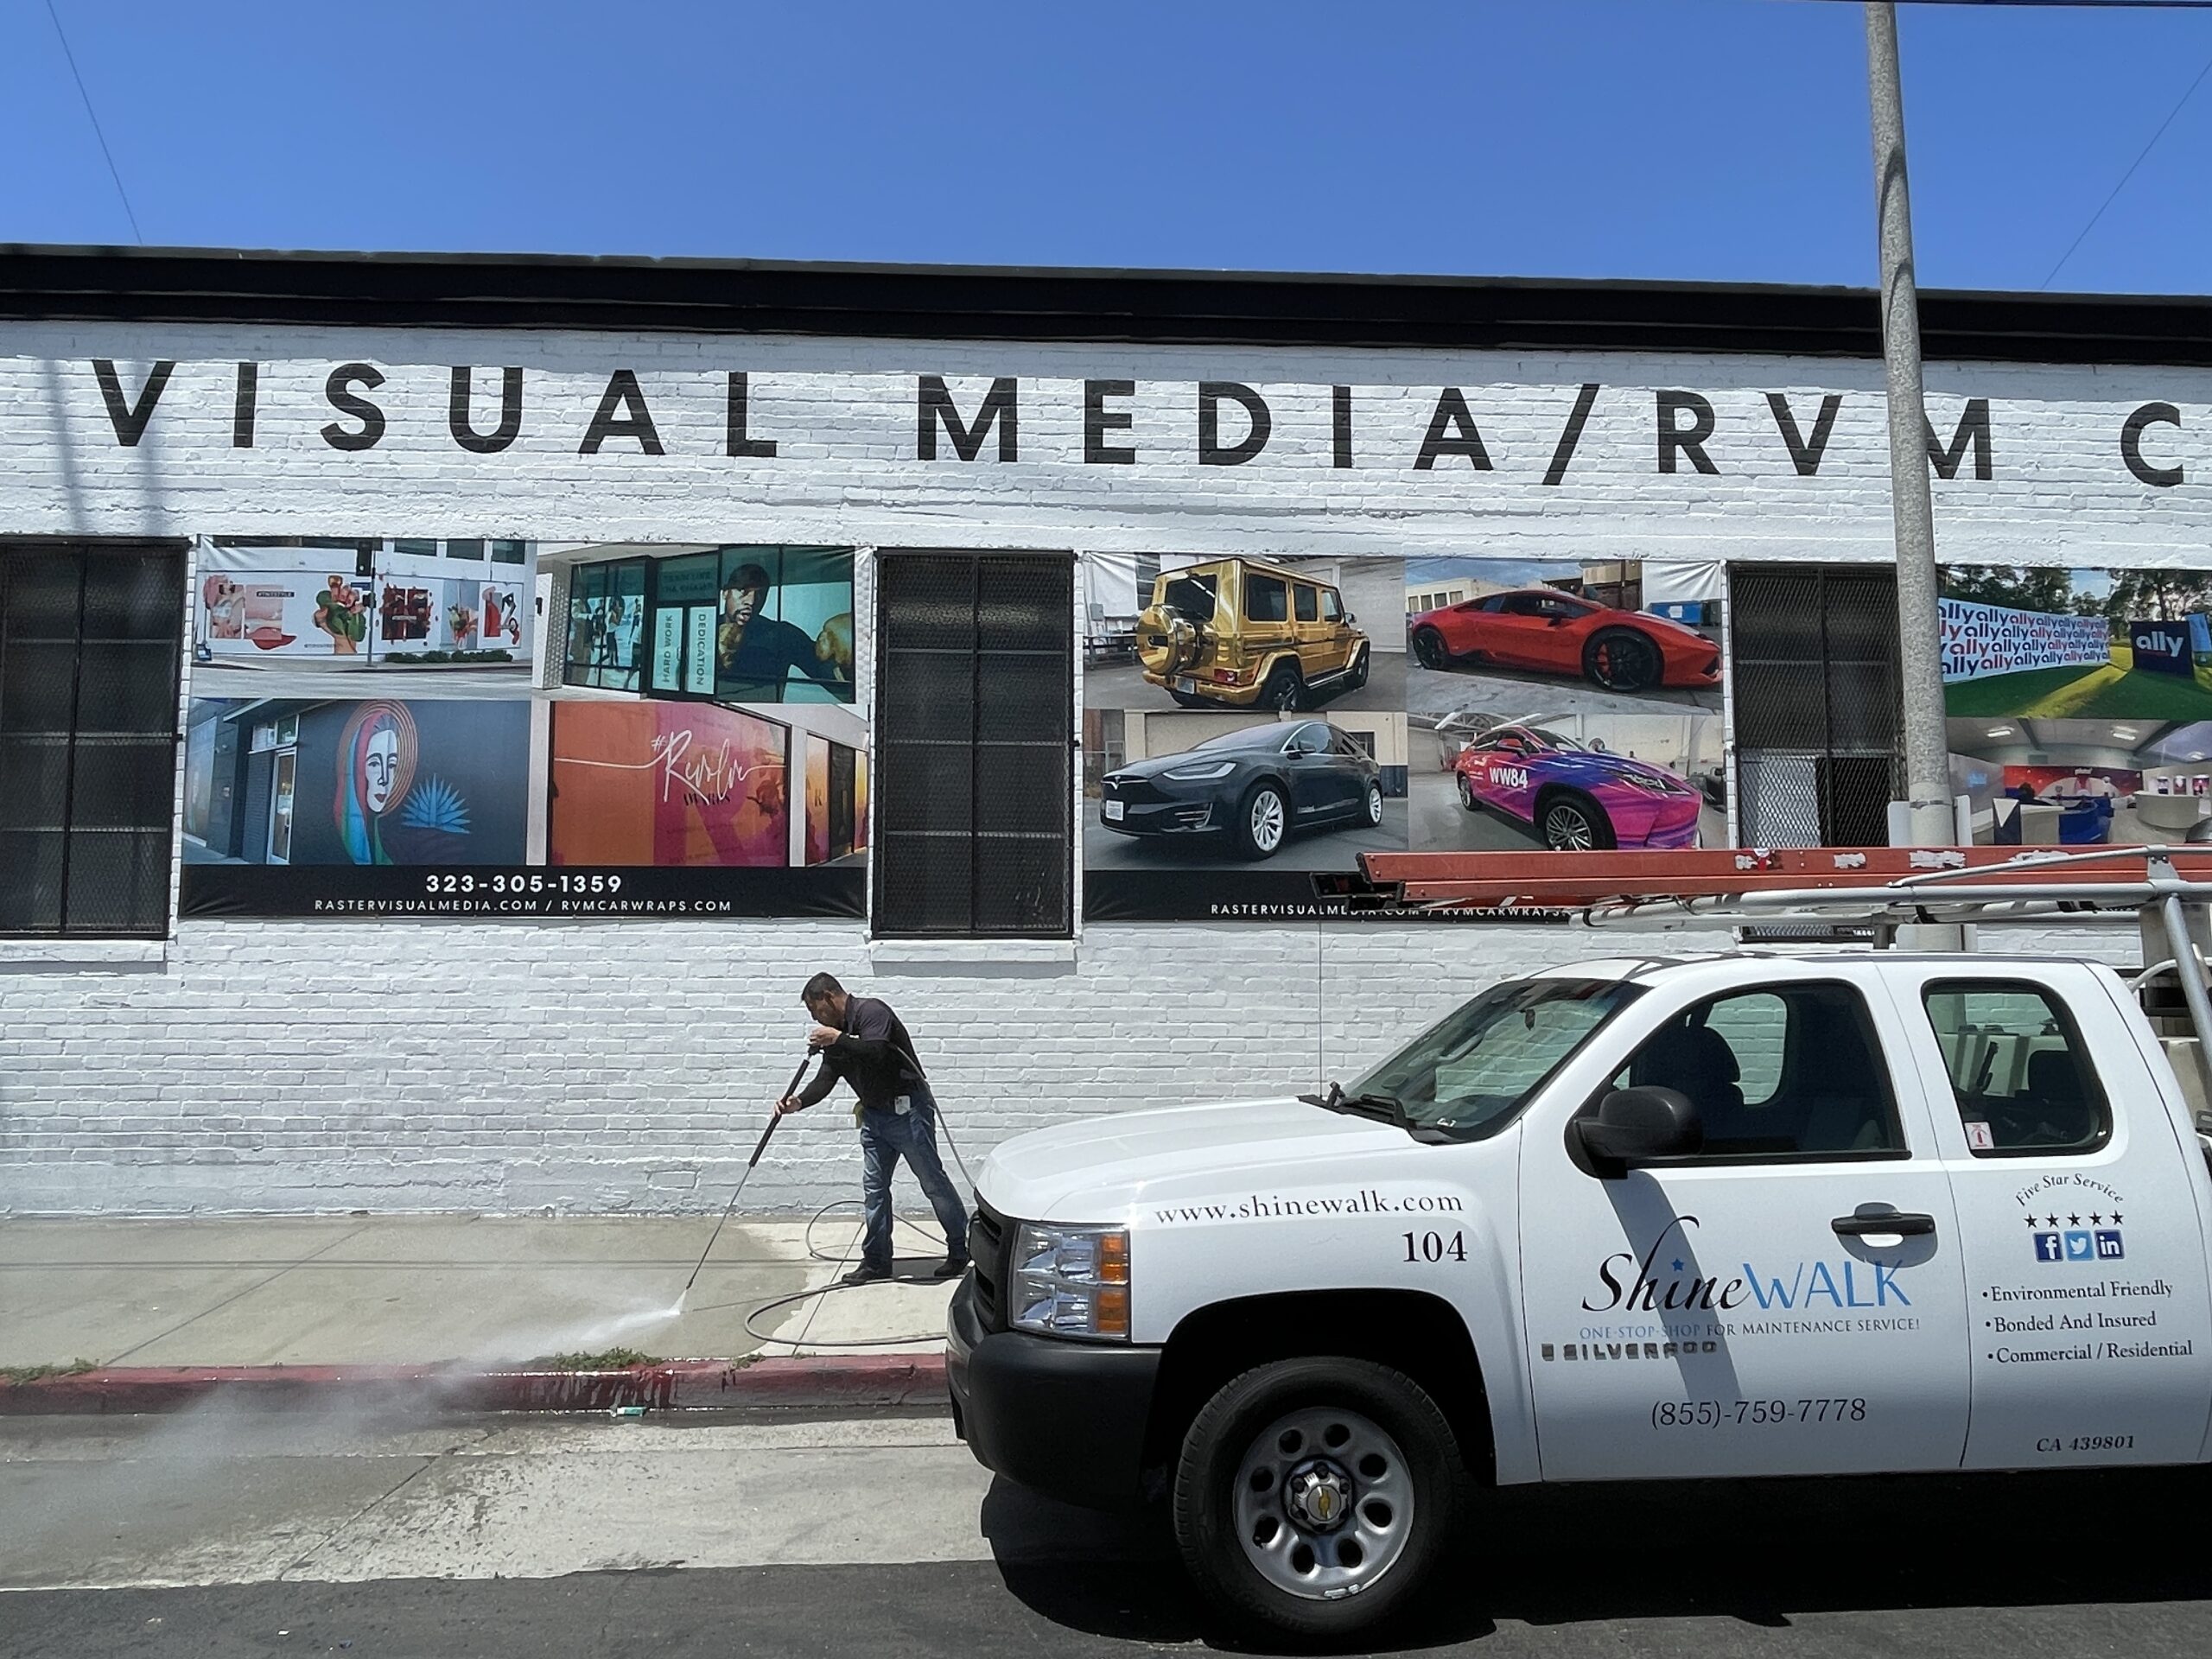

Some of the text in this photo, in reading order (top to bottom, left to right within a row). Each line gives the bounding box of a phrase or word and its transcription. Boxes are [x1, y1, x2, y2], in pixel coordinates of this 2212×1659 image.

[91, 359, 779, 459] VISUAL
[663, 614, 673, 683] HARD WORK
[696, 613, 707, 686] DEDICATION
[2135, 631, 2184, 658] ally
[1489, 766, 1529, 789] WW84
[425, 874, 622, 893] 323-305-1359
[314, 899, 538, 912] RASTERVISUALMEDIA.COM
[561, 900, 732, 912] RVMCARWRAPS.COM
[2015, 1173, 2124, 1208] Five Star Service
[1156, 1190, 1465, 1224] www.shinewalk.com
[1401, 1230, 1469, 1263] 104
[1990, 1279, 2174, 1302] Environmental Friendly
[1579, 1318, 1921, 1340] ONE-STOP-SHOP FOR MAINTENANCE SERVICE!
[1993, 1310, 2158, 1333] Bonded And Insured
[1996, 1343, 2093, 1363] Commercial
[2106, 1339, 2194, 1360] Residential
[1651, 1397, 1867, 1430] (855)-759-7778
[2036, 1435, 2134, 1452] CA 439801
